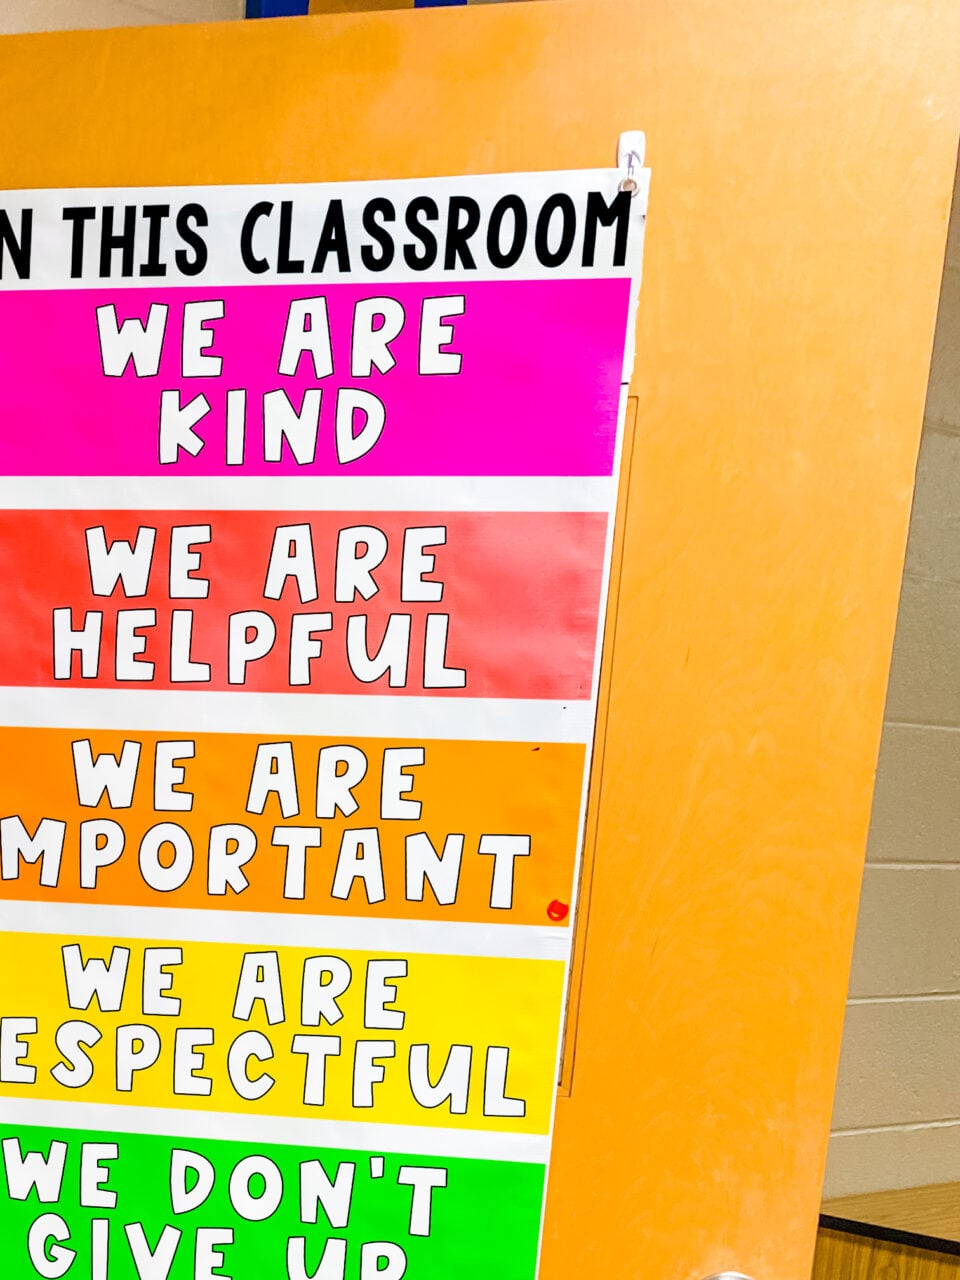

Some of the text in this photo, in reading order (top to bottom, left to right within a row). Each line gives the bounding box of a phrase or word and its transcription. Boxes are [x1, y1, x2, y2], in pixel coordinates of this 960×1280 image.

[62, 202, 209, 279] THIS
[239, 191, 633, 277] CLASSROOM
[96, 295, 466, 380] WE ARE
[158, 387, 387, 466] KIND
[84, 523, 447, 604] WE ARE
[51, 607, 467, 690] HELPFUL
[71, 738, 426, 821] WE ARE
[61, 942, 409, 1031] WE ARE
[0, 1136, 448, 1238] WE DON'T
